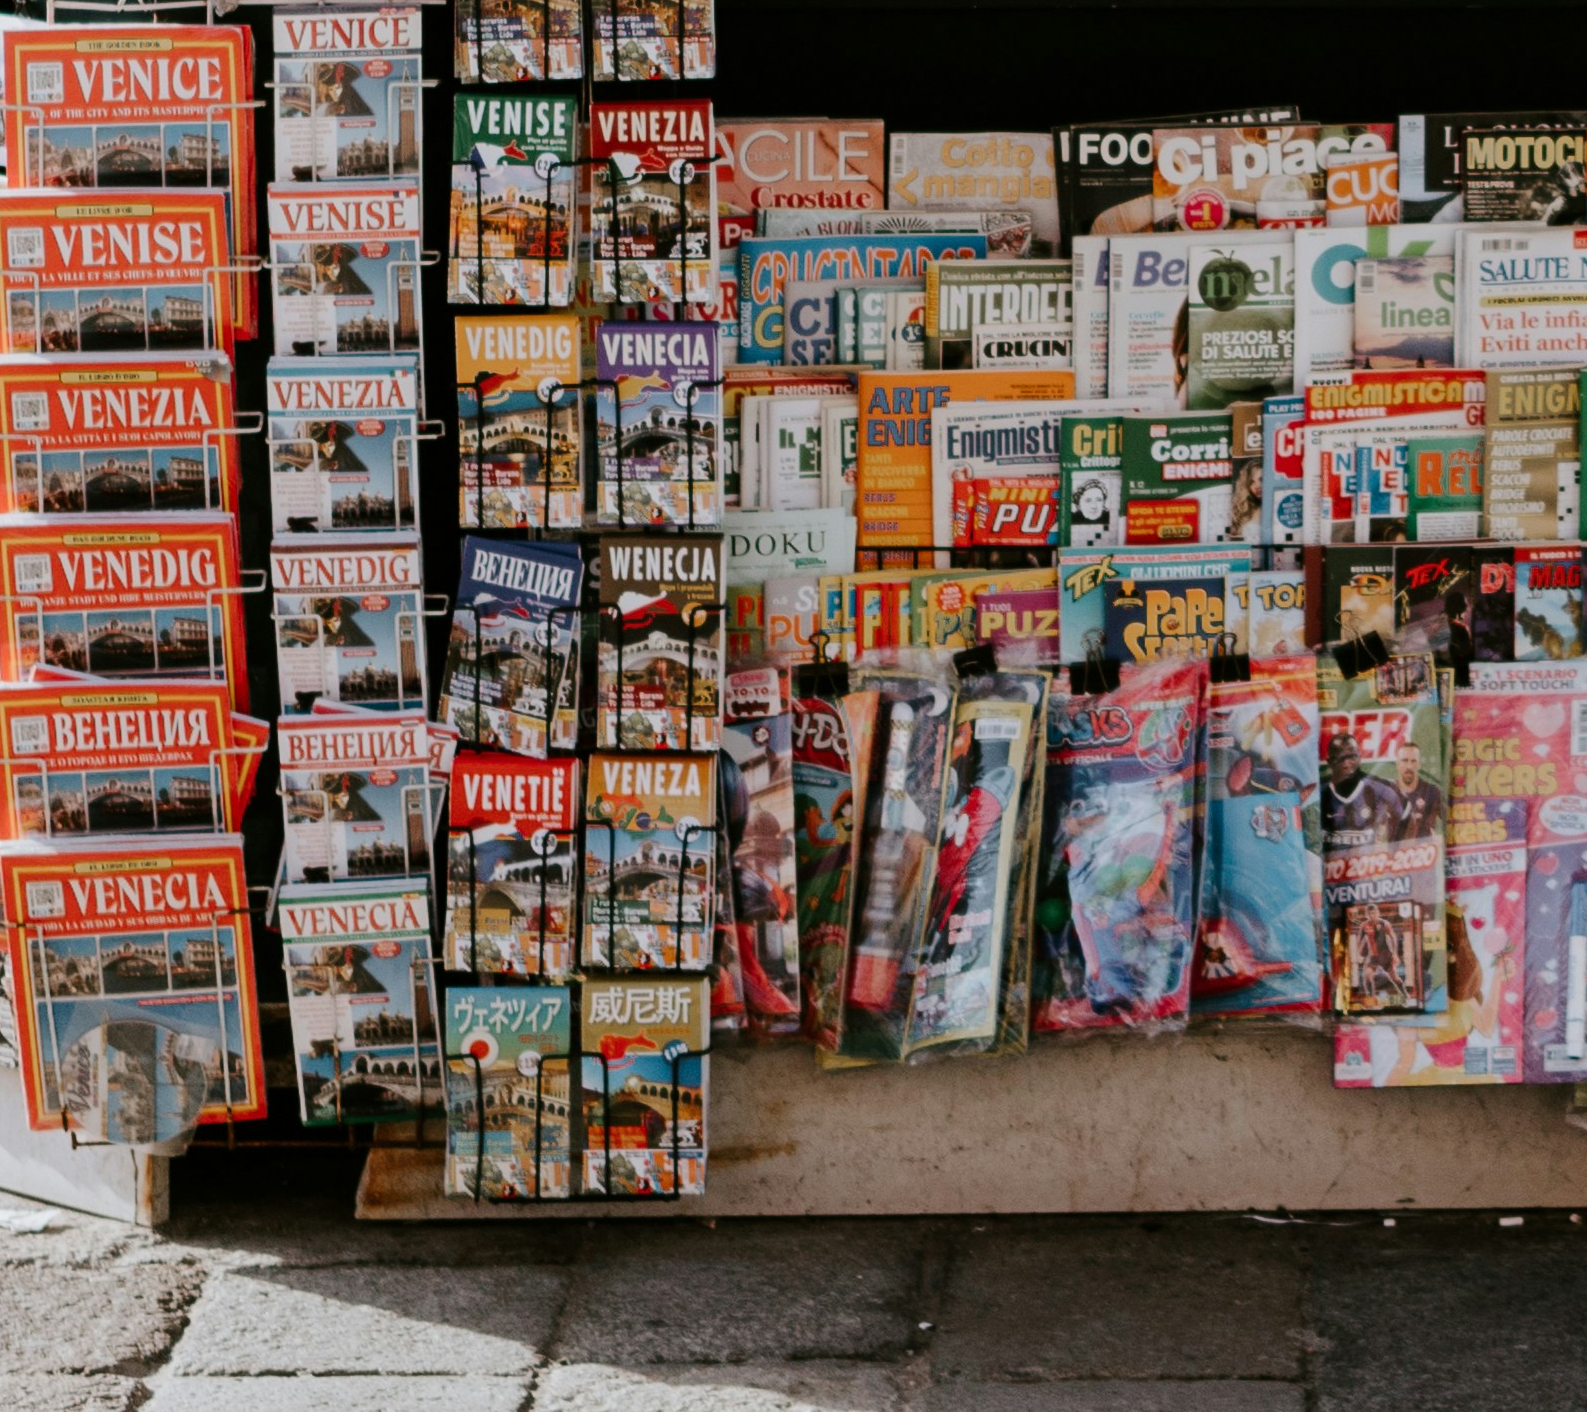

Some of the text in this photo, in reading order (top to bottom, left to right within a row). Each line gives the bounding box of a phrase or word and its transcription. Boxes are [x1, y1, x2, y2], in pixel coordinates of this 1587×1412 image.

[282, 16, 412, 50] VENICE
[72, 57, 223, 103] VENICE
[65, 107, 150, 118] THE CITY AND ITS
[467, 100, 567, 137] VENISE
[598, 111, 705, 142] VENEZIA
[940, 138, 1036, 168] Cotto
[750, 187, 872, 209] Crostate
[279, 200, 407, 233] VENISE
[51, 222, 205, 267] VENISE
[57, 272, 84, 281] VILLE
[1479, 257, 1569, 283] SALUTE
[1201, 330, 1268, 345] PREZIOSI
[1479, 311, 1539, 331] Via le
[465, 326, 572, 360] VENEDIG
[602, 333, 709, 366] VENECIA
[1223, 343, 1278, 359] SALUTE
[1479, 332, 1523, 354] Eviti
[57, 387, 211, 429] VENEZIA
[272, 377, 407, 412] VENEZIA
[868, 386, 951, 415] ARTE
[1311, 376, 1463, 408] ENIGMISTICA
[1338, 407, 1387, 420] PAGINE
[143, 431, 202, 440] CAPOLAVORI
[57, 548, 216, 592] VENEDIG
[273, 554, 411, 588] VENEDIG
[471, 549, 575, 604] ВЕНЕЦИЯ
[609, 546, 716, 582] WENECJA
[69, 595, 117, 605] STADT UND
[1478, 680, 1576, 693] SOFT TOUCH!
[1503, 669, 1578, 680] SCENARIO
[52, 708, 211, 753] ВЕНЕЦИЯ
[287, 728, 418, 765] ВЕНЕЦИЯ
[463, 768, 565, 812] VENETIË
[603, 762, 701, 796] VENEZA
[1349, 846, 1437, 877] 2019-2020
[67, 872, 227, 916] VENECIA
[285, 903, 422, 938] VENECIA
[589, 986, 691, 1024] 威尼斯
